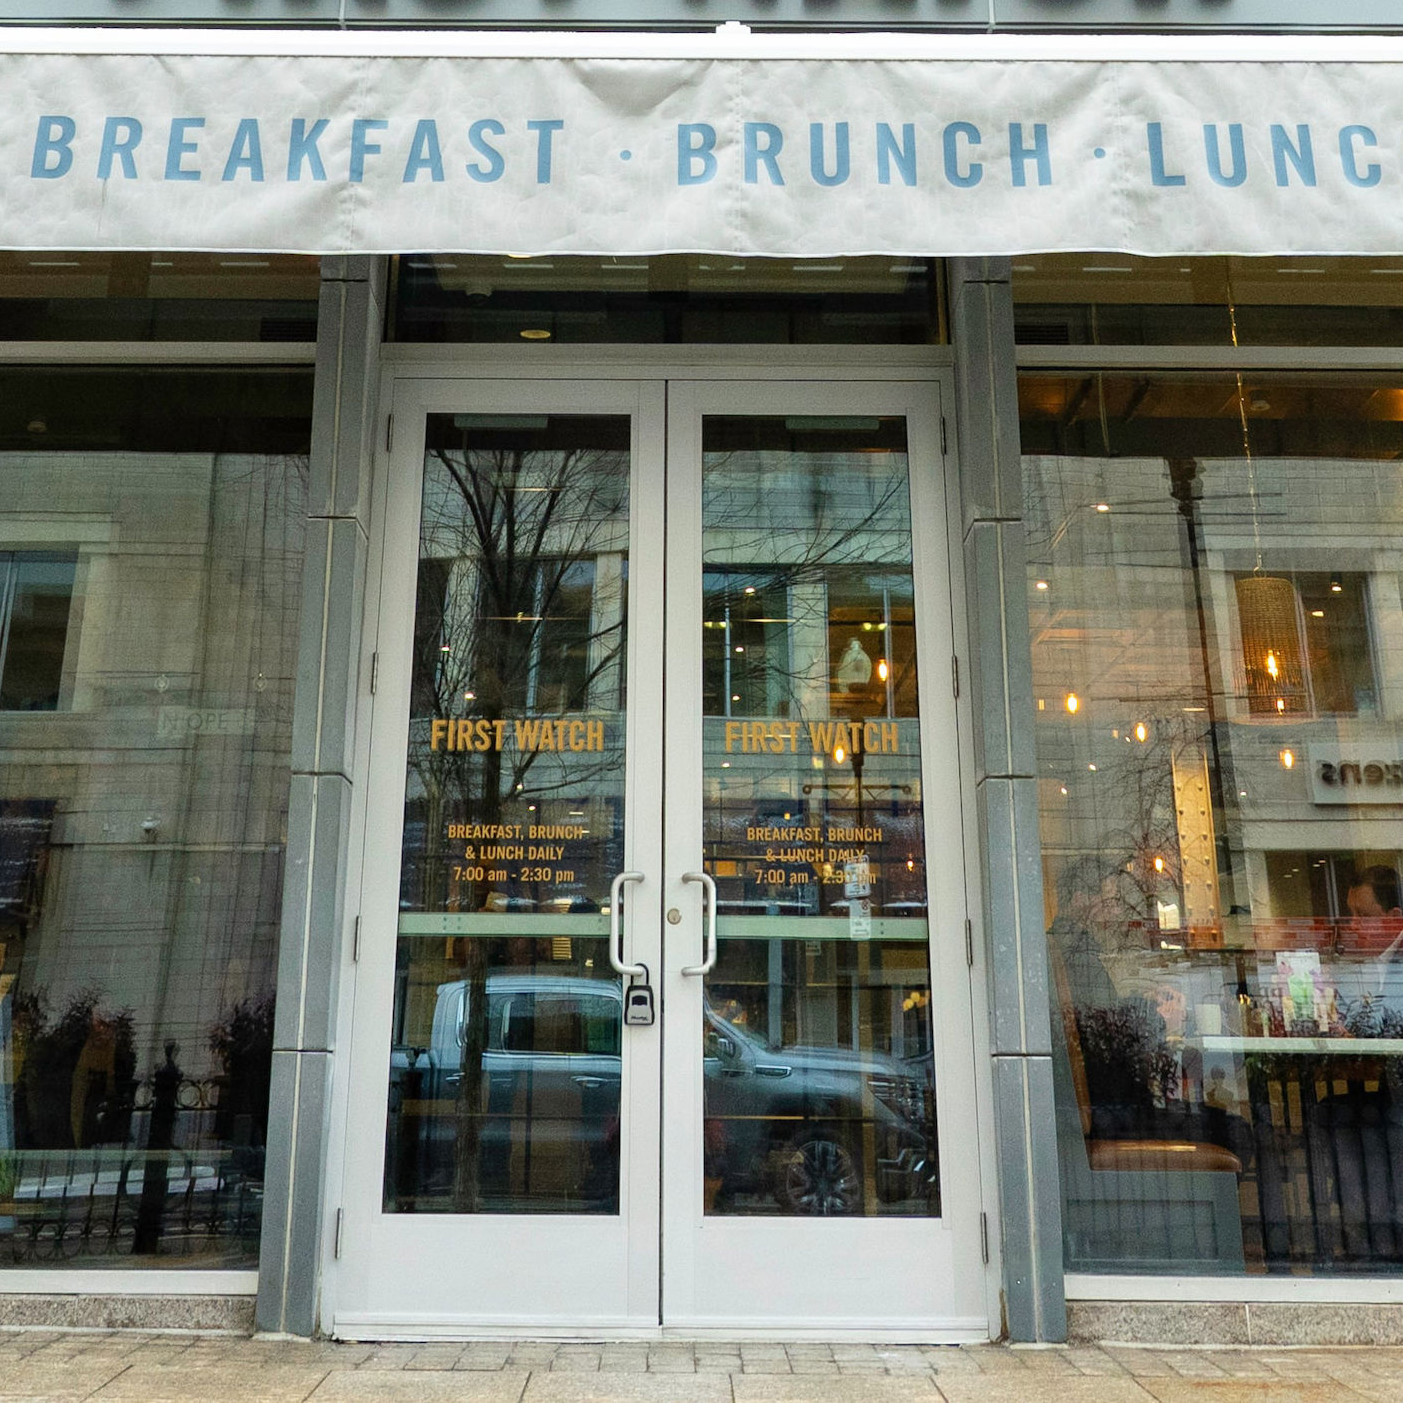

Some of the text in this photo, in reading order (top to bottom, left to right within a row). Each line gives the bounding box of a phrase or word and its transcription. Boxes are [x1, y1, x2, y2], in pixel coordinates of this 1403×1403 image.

[30, 114, 566, 185] BREAKFAST
[675, 121, 1054, 188] BRUNCH
[430, 718, 604, 752] FIRST WATCH
[724, 720, 898, 755] FIRST WATCH
[448, 824, 583, 841] BREAKFAST, BRUNCH
[746, 827, 883, 843] BREAKFAST, BRUNCH
[465, 845, 564, 861] & LUNCH DAILY
[765, 848, 865, 863] & LUNCH DAILY
[453, 866, 484, 882] 7:00
[487, 869, 507, 882] am
[520, 867, 552, 882] 2:30
[555, 870, 575, 885] pm
[754, 869, 786, 885] 7:00
[789, 872, 809, 885] am
